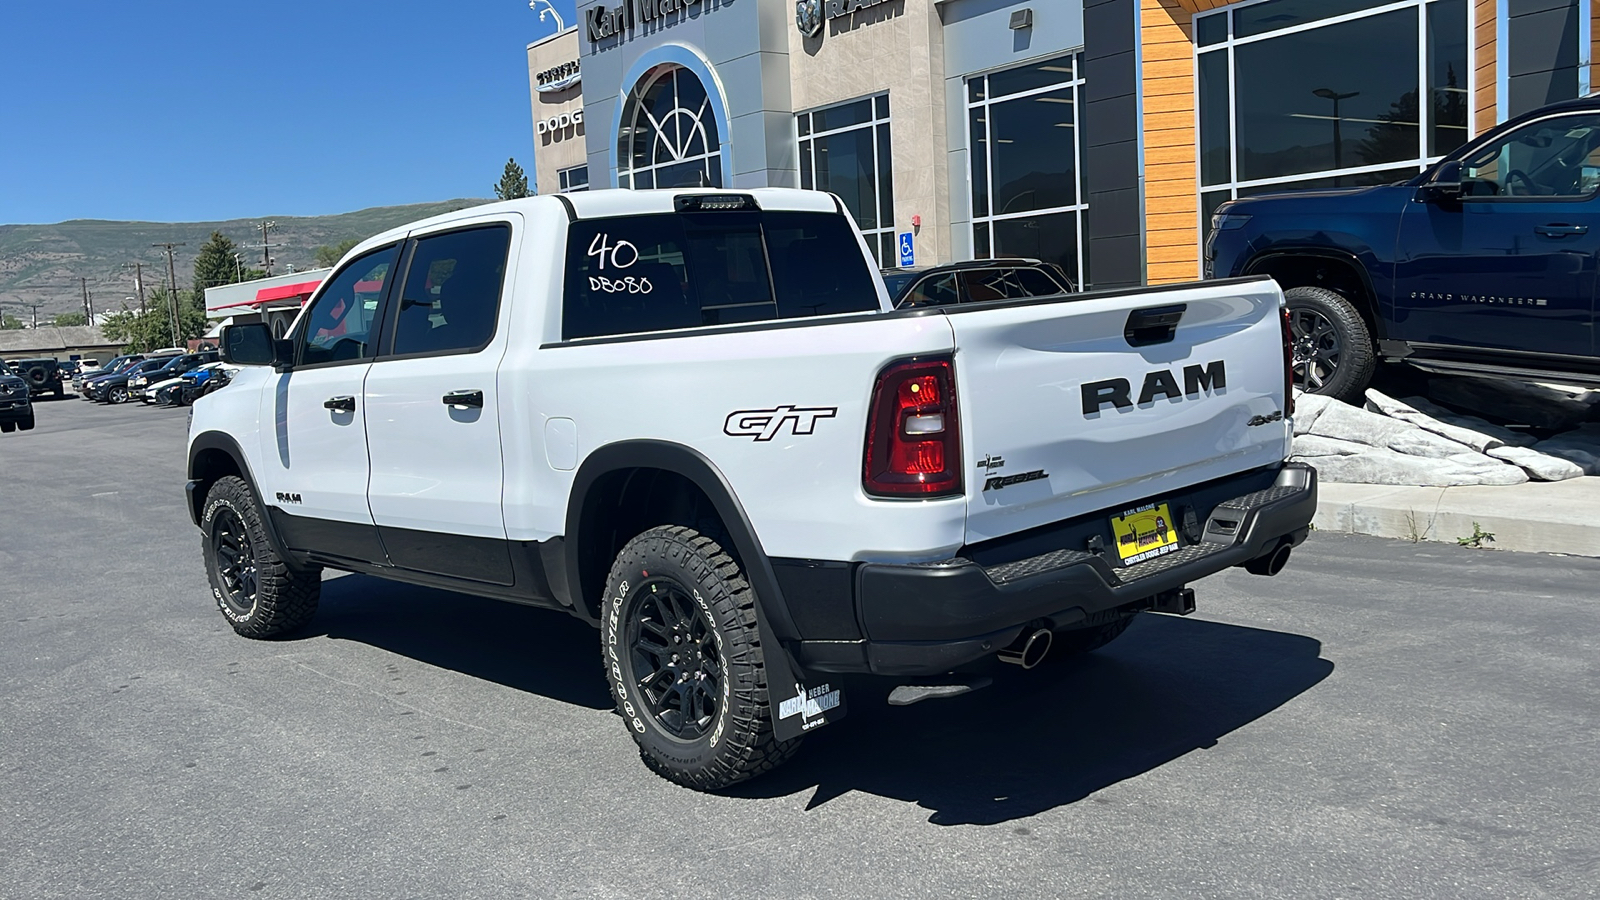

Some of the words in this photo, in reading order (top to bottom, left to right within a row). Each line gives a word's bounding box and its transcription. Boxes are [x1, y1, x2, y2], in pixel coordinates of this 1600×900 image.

[585, 0, 630, 43] Karl
[587, 233, 638, 269] 40
[1410, 291, 1452, 301] GRAND
[1460, 294, 1533, 305] WAGONEER
[1081, 360, 1226, 414] RAM
[276, 492, 302, 502] RAM
[808, 683, 830, 699] HEBER
